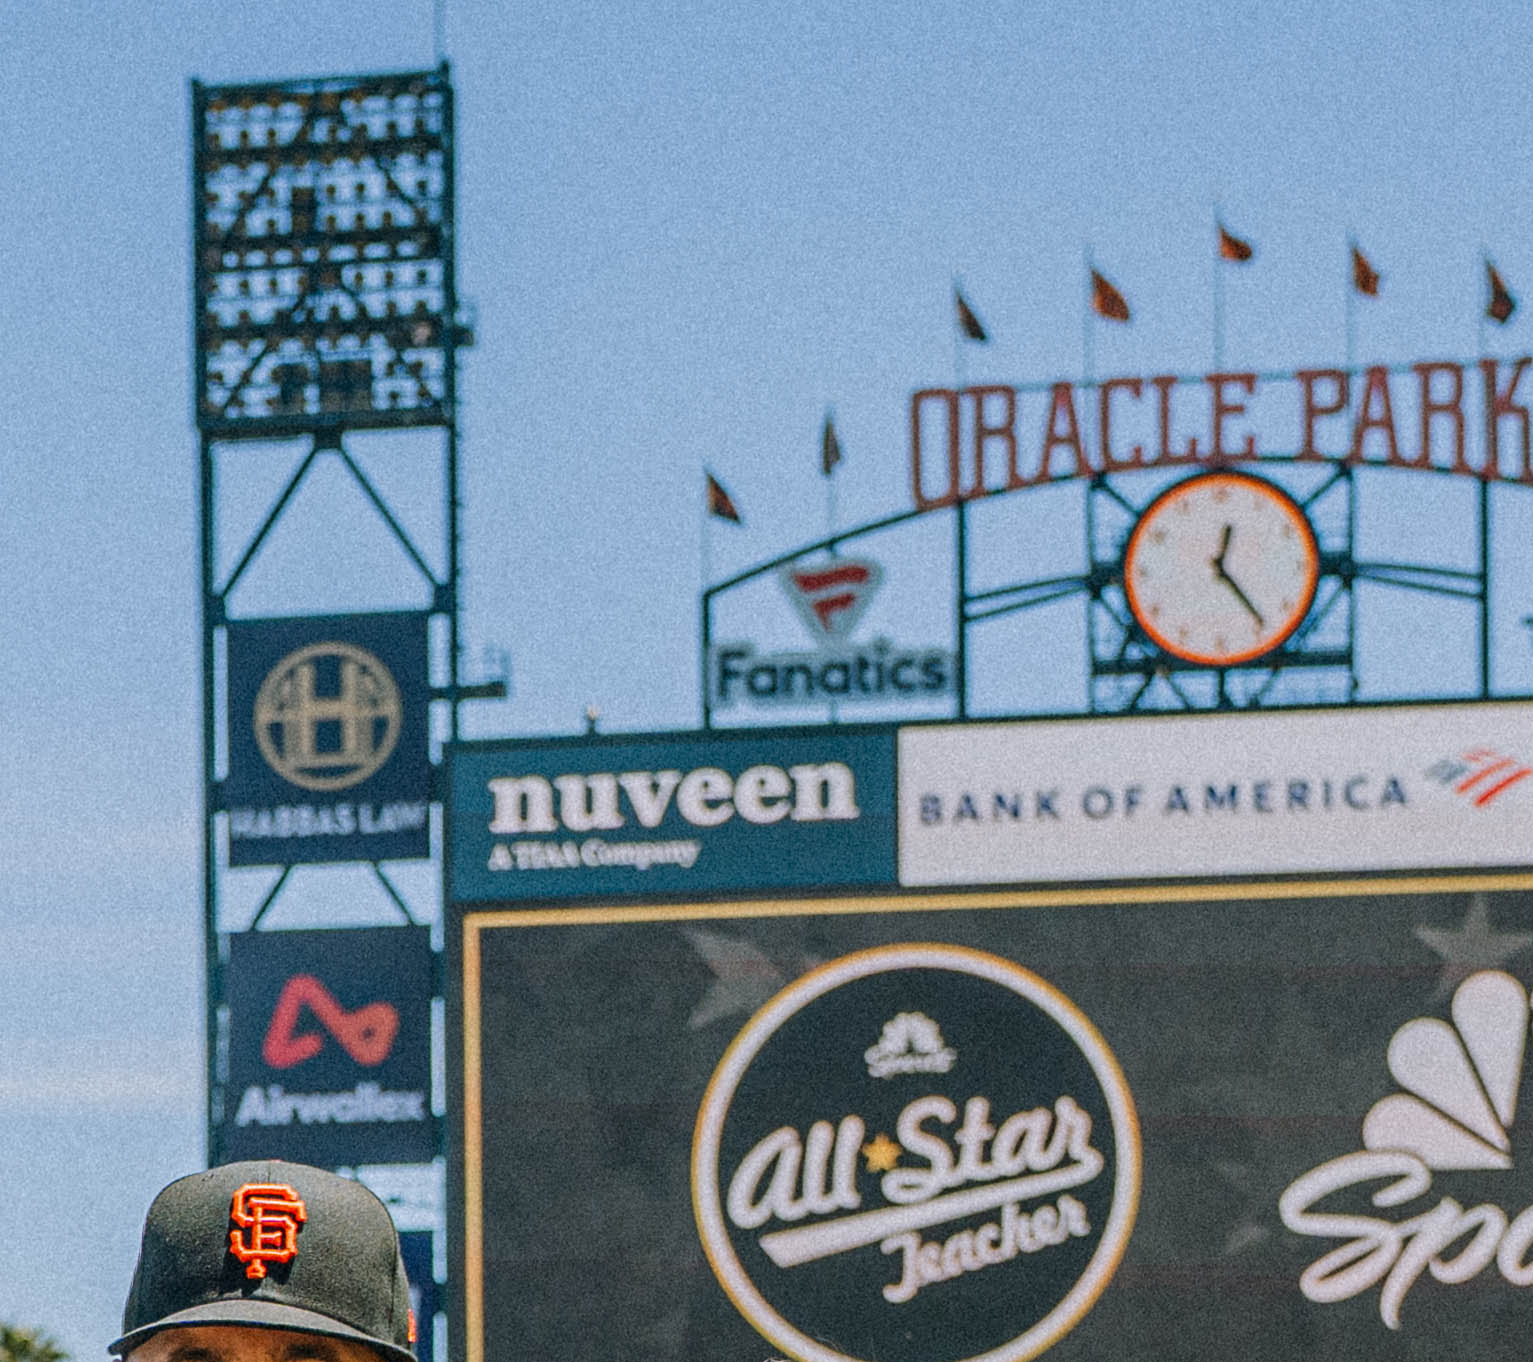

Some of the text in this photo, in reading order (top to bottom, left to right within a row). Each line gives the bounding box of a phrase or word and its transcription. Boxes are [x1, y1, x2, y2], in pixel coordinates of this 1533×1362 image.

[909, 372, 1256, 510] ORACLE
[713, 643, 949, 702] Fanatics
[487, 760, 860, 834] nuveen
[919, 776, 1409, 827] BANK OF AMERICA
[487, 843, 513, 871] A
[582, 837, 702, 872] Company
[237, 1082, 427, 1127] Airwallex
[726, 1094, 1104, 1230] All Star
[880, 1195, 1091, 1304] Teacher
